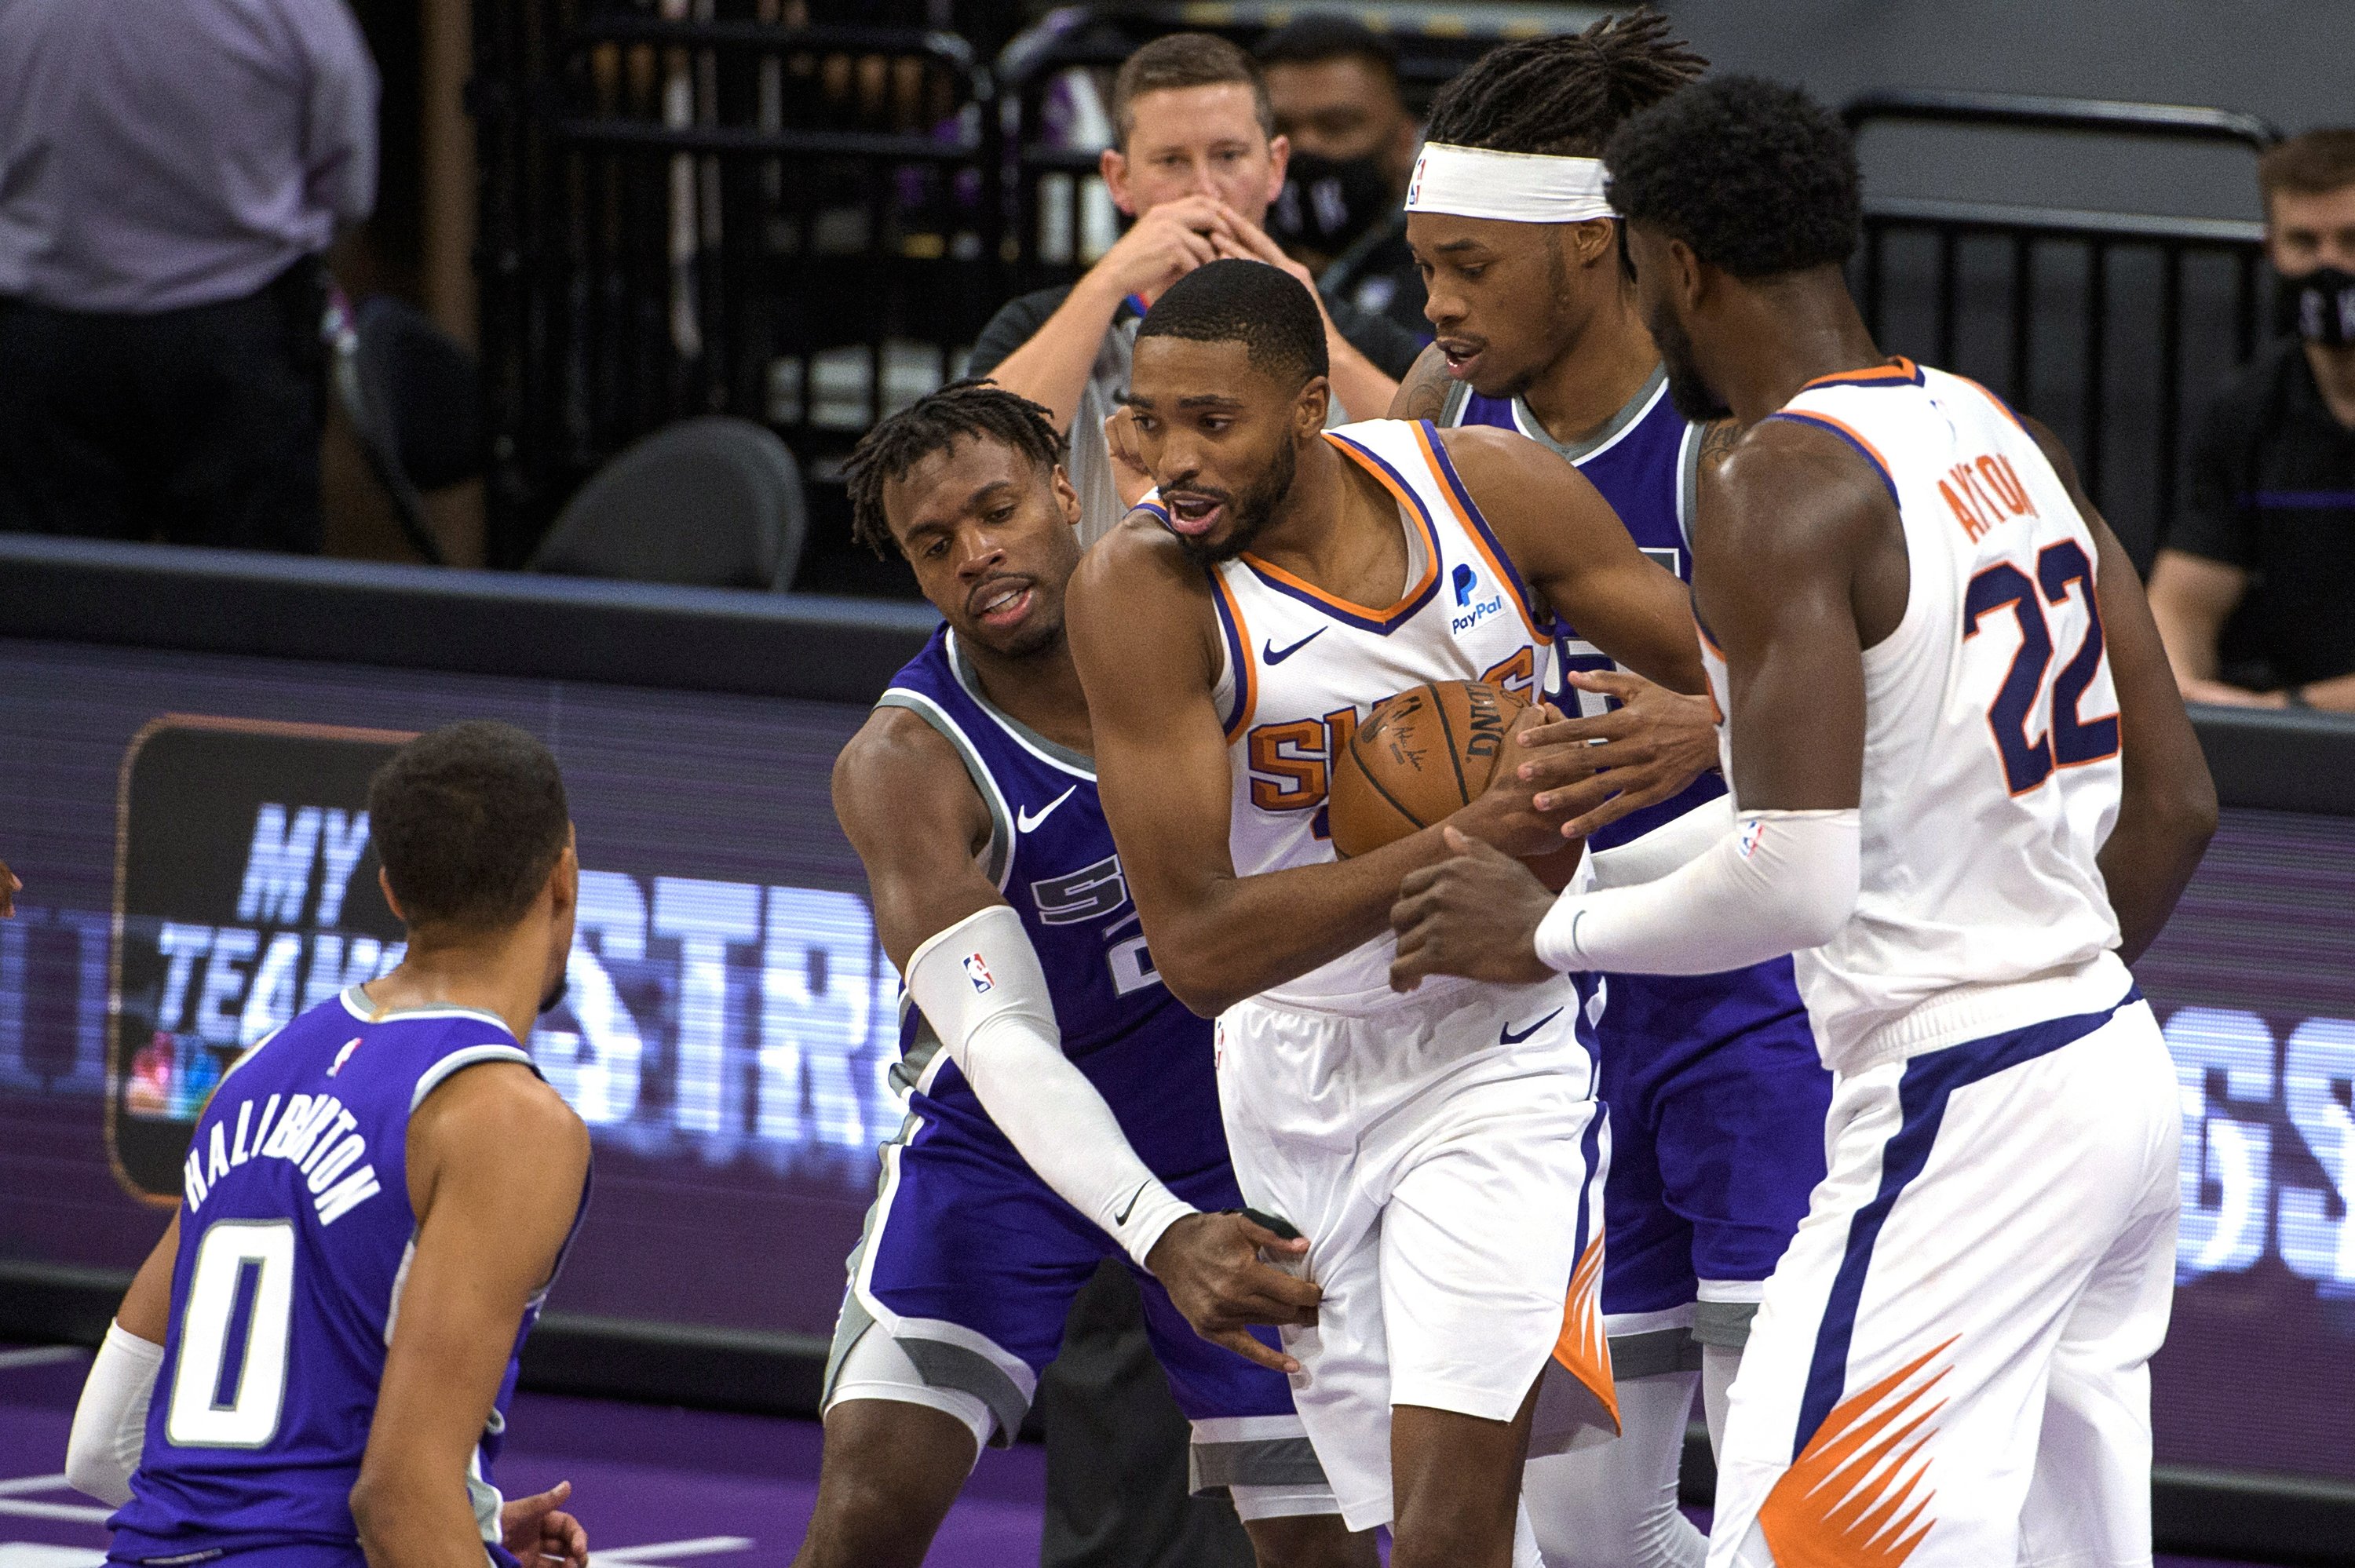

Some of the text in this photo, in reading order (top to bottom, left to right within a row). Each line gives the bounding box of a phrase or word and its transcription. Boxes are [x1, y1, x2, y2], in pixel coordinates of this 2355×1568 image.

[1452, 595, 1502, 635] PayPal
[1964, 538, 2121, 798] 22
[237, 802, 370, 927] MY
[159, 921, 409, 1048] TEAM
[165, 1218, 296, 1449] 0
